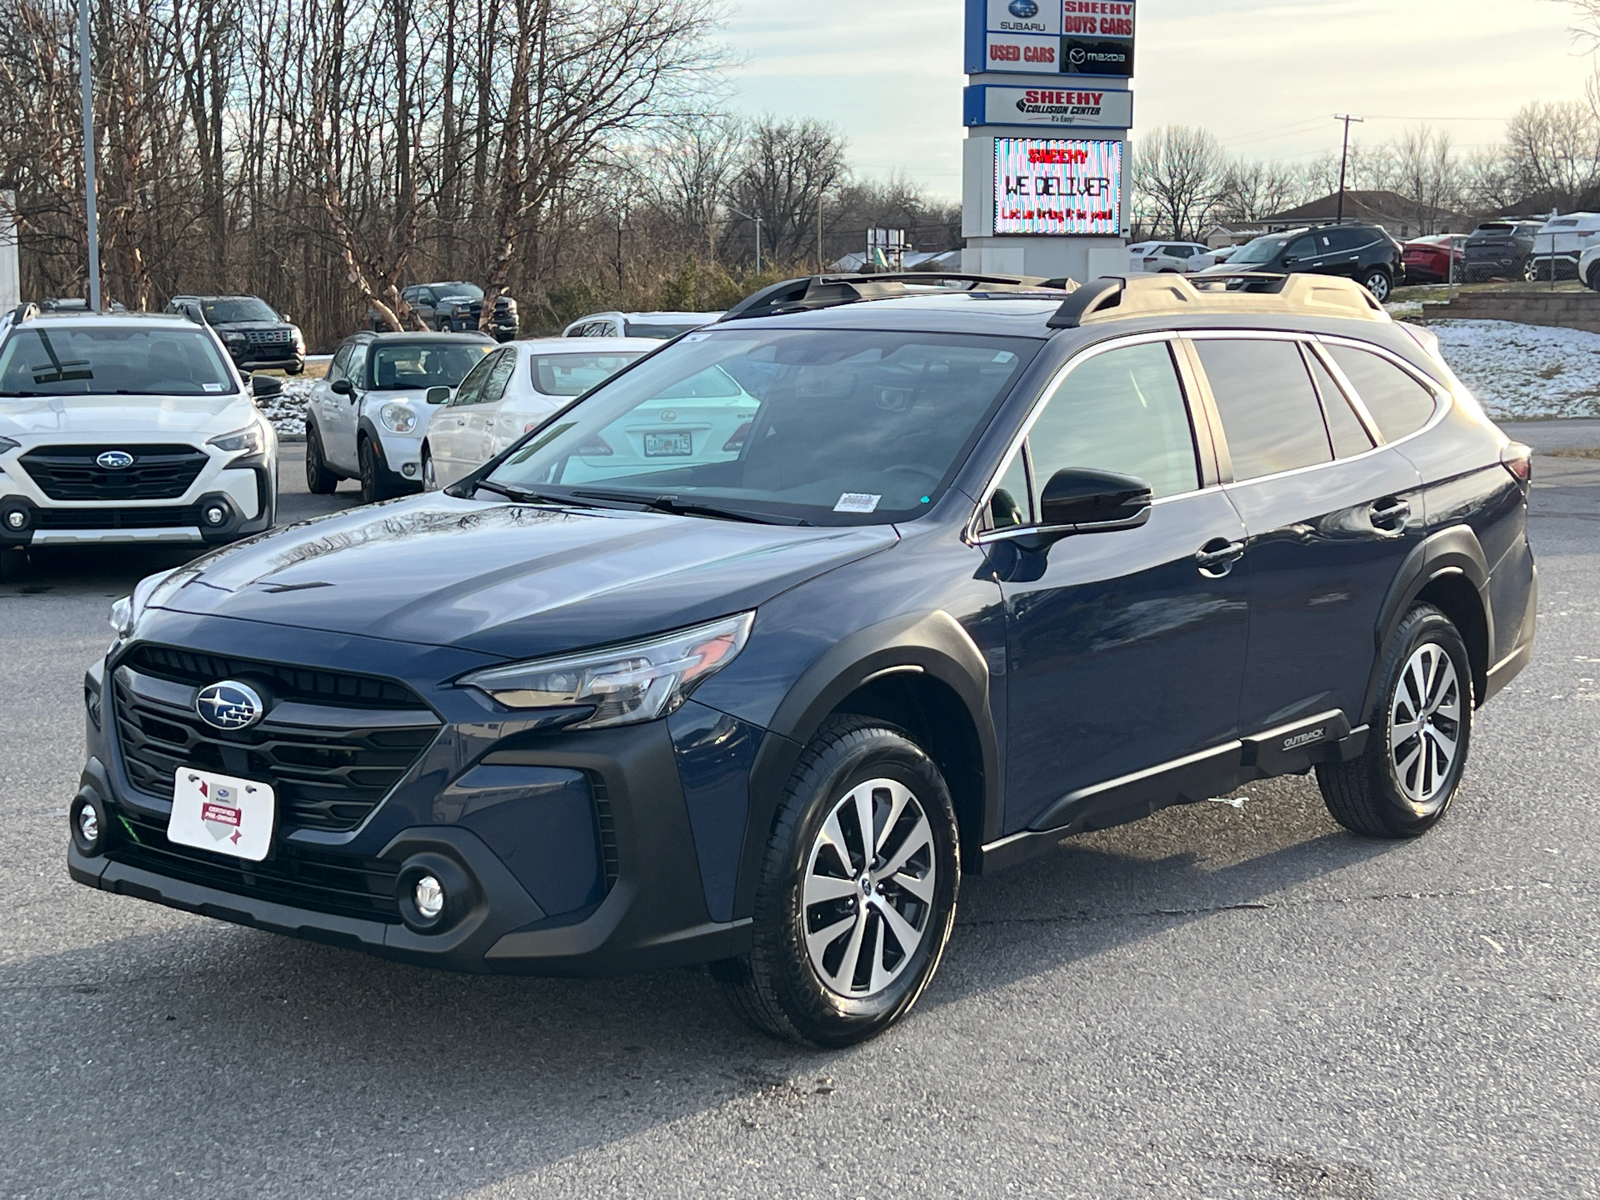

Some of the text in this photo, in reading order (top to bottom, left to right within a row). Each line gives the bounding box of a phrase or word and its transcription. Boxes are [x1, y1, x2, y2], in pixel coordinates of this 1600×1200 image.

[1065, 1, 1133, 15] SHEEHY
[1000, 21, 1045, 31] SUBARU
[1065, 15, 1132, 35] BUYS CARS
[990, 44, 1055, 63] USED CARS
[1025, 90, 1103, 105] SHEEHY
[1025, 104, 1102, 116] COLLISION CENTER
[1005, 175, 1110, 196] WE DELIVER
[1283, 727, 1325, 747] OUTBACK
